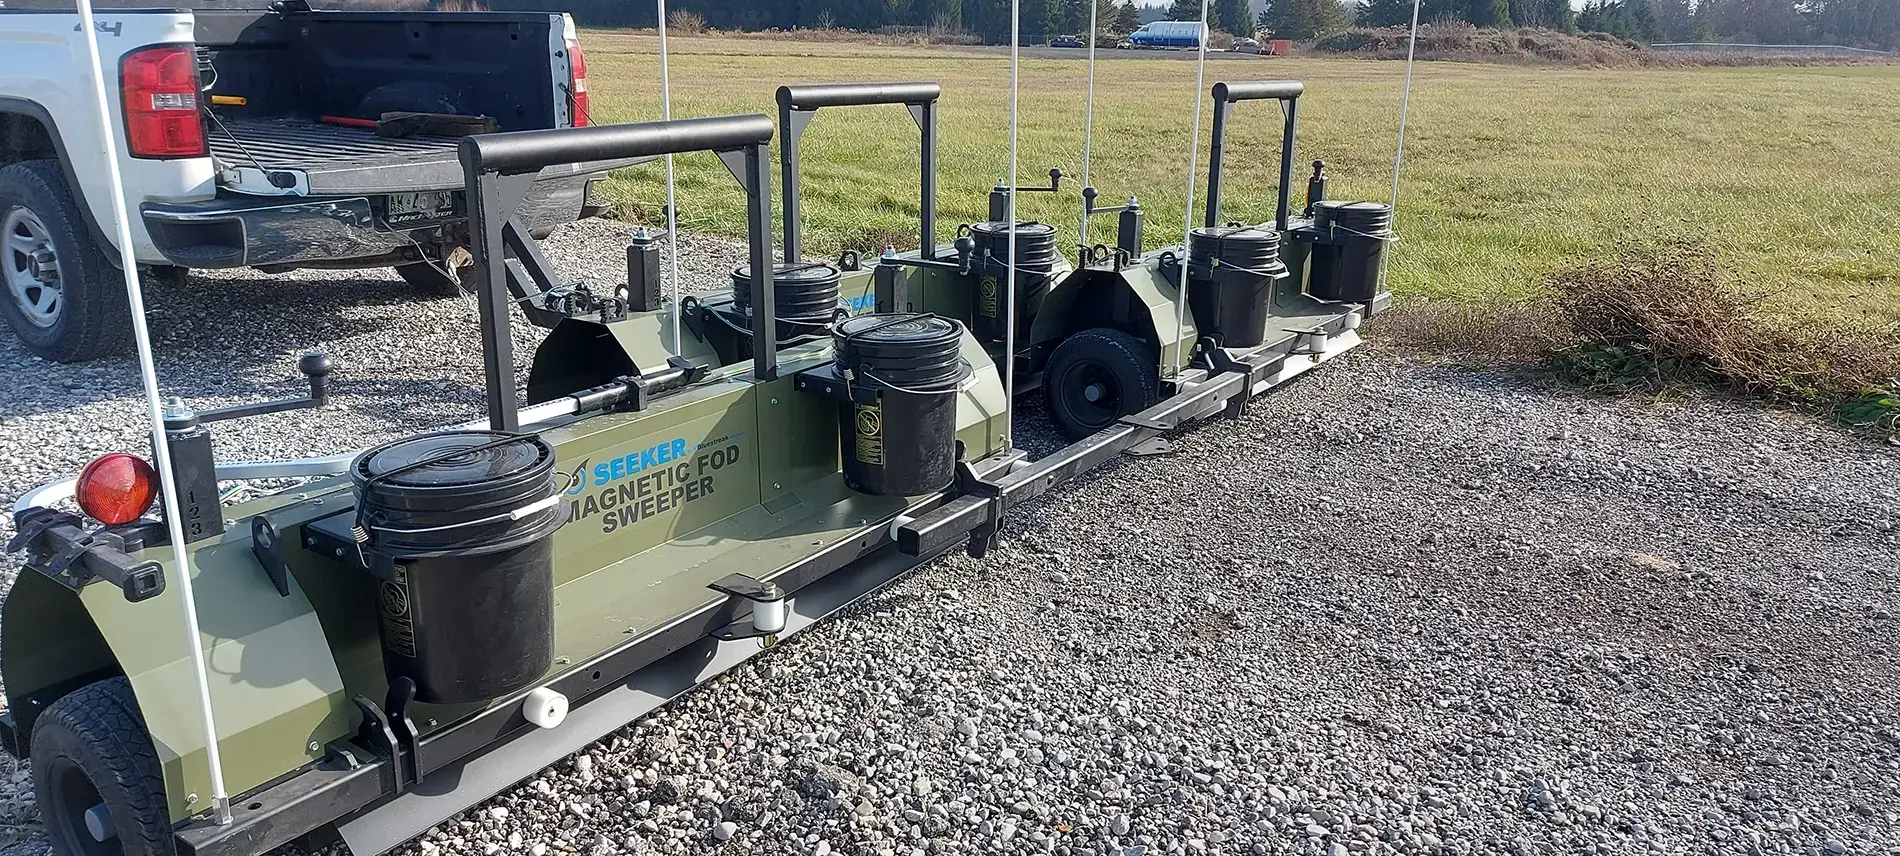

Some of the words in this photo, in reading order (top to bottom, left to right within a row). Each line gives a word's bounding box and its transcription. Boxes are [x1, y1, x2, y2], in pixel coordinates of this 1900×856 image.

[593, 437, 686, 486] SEEKER
[188, 490, 196, 504] 1
[567, 462, 690, 524] MAGNETIC
[697, 444, 740, 477] FOD
[188, 506, 201, 520] 2
[602, 475, 715, 534] SWEEPER
[191, 522, 202, 536] 3
